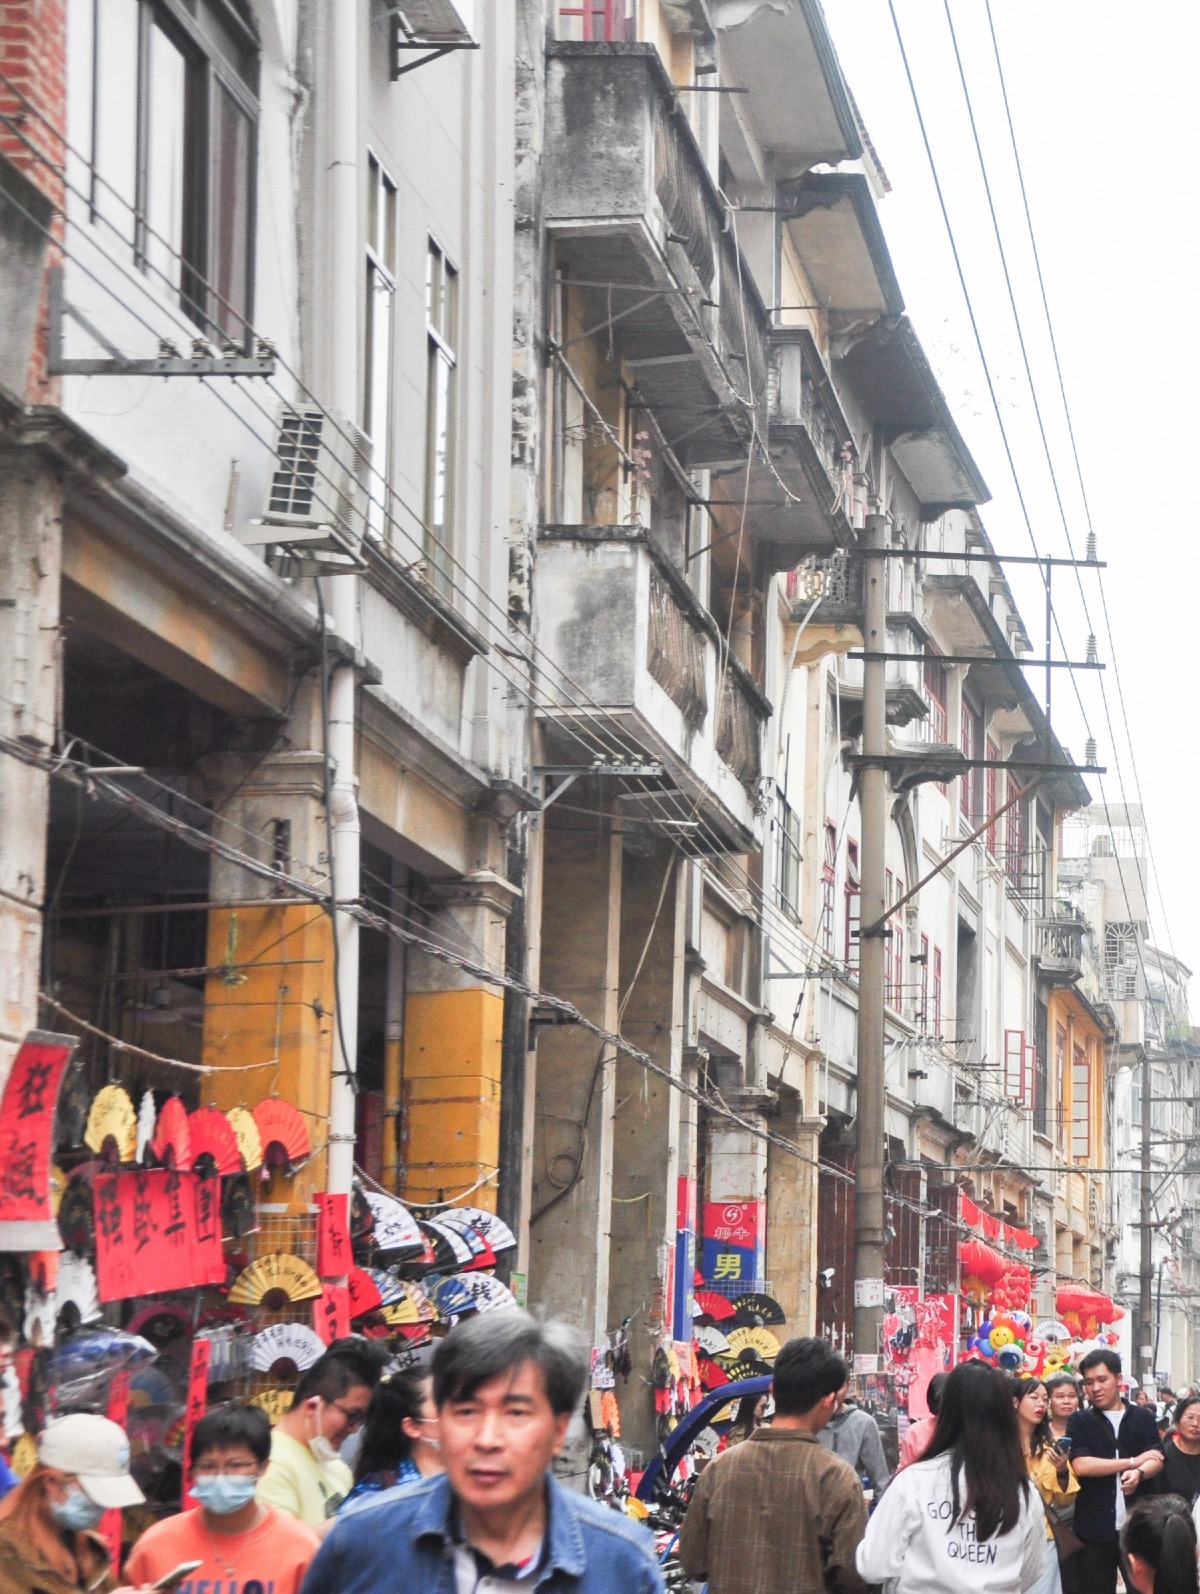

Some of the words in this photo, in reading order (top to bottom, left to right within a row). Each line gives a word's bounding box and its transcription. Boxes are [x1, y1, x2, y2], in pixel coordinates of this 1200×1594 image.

[714, 1227, 750, 1240] 椰牛
[713, 1254, 742, 1280] 男
[927, 1500, 961, 1520] GO
[957, 1522, 982, 1541] TH
[947, 1541, 998, 1564] QUEEN
